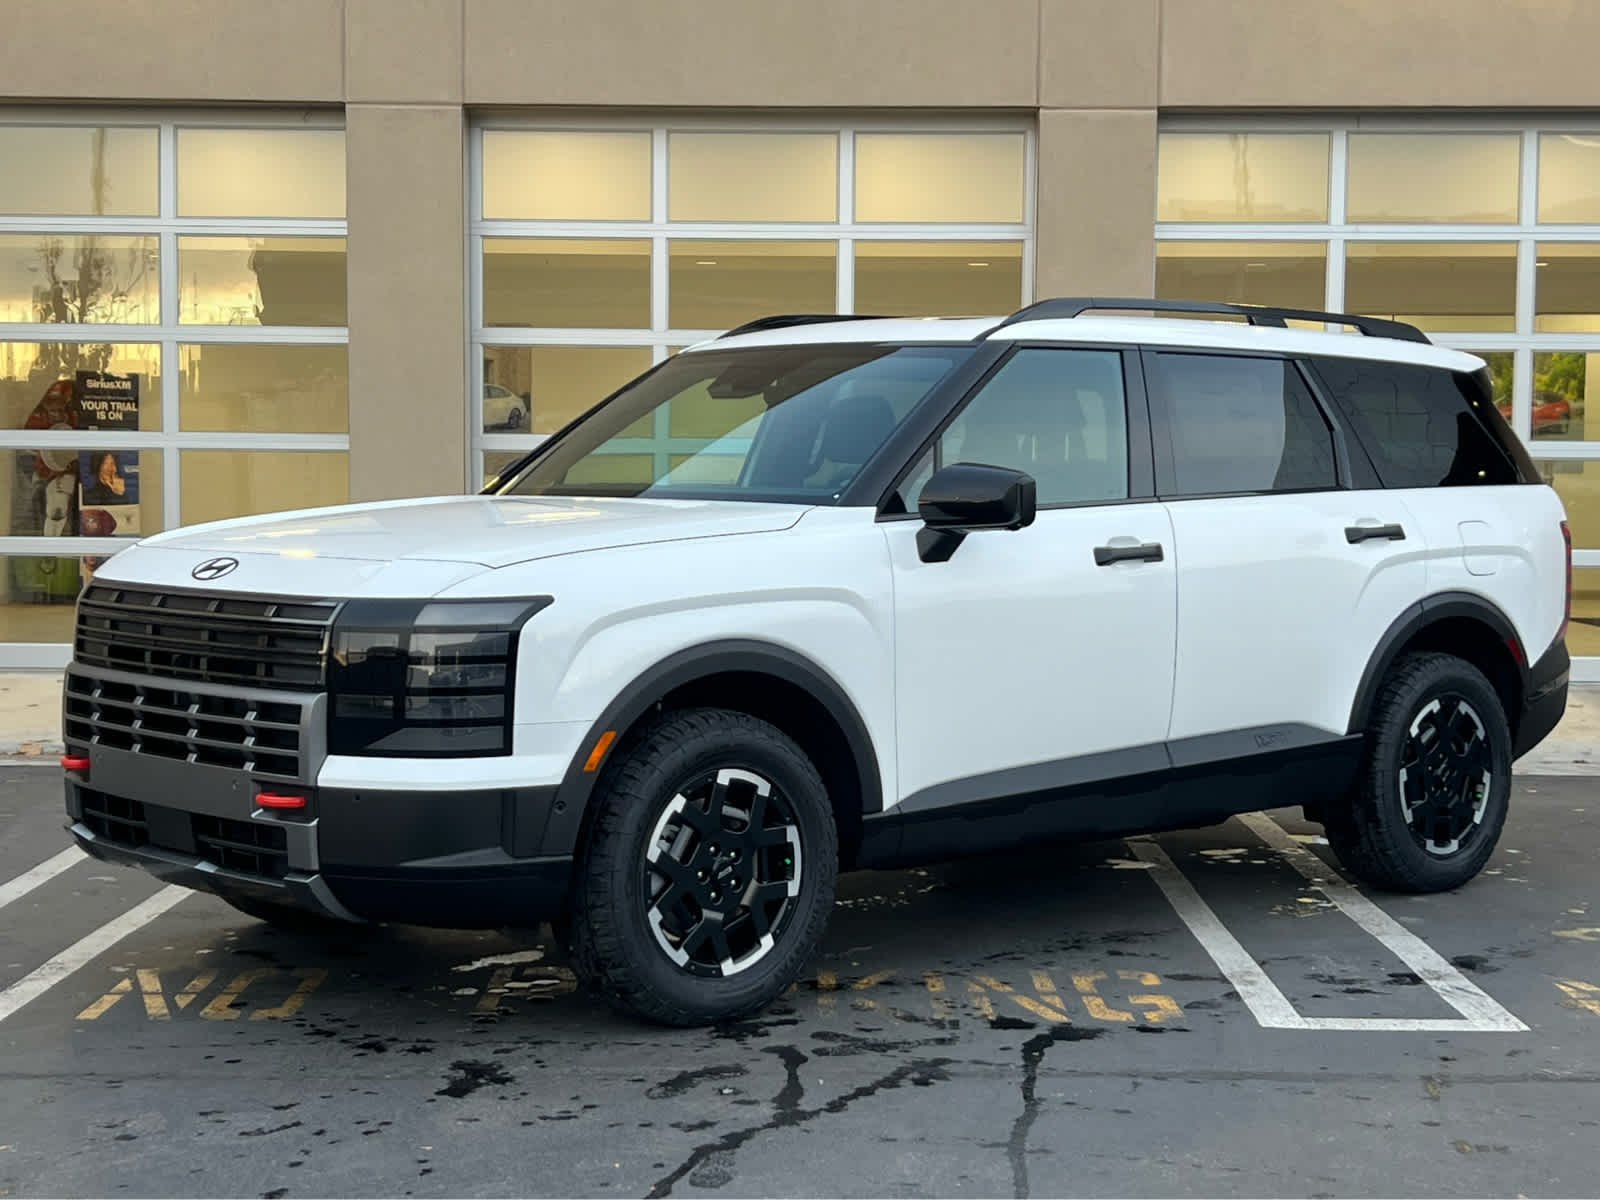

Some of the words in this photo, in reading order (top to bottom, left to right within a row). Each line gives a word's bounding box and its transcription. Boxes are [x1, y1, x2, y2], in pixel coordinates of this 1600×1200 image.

[86, 378, 131, 390] SiriusXM
[81, 400, 108, 411] YOUR
[110, 401, 137, 411] TRIAL
[97, 411, 106, 420] IS
[108, 411, 123, 421] ON
[73, 967, 328, 1021] NO
